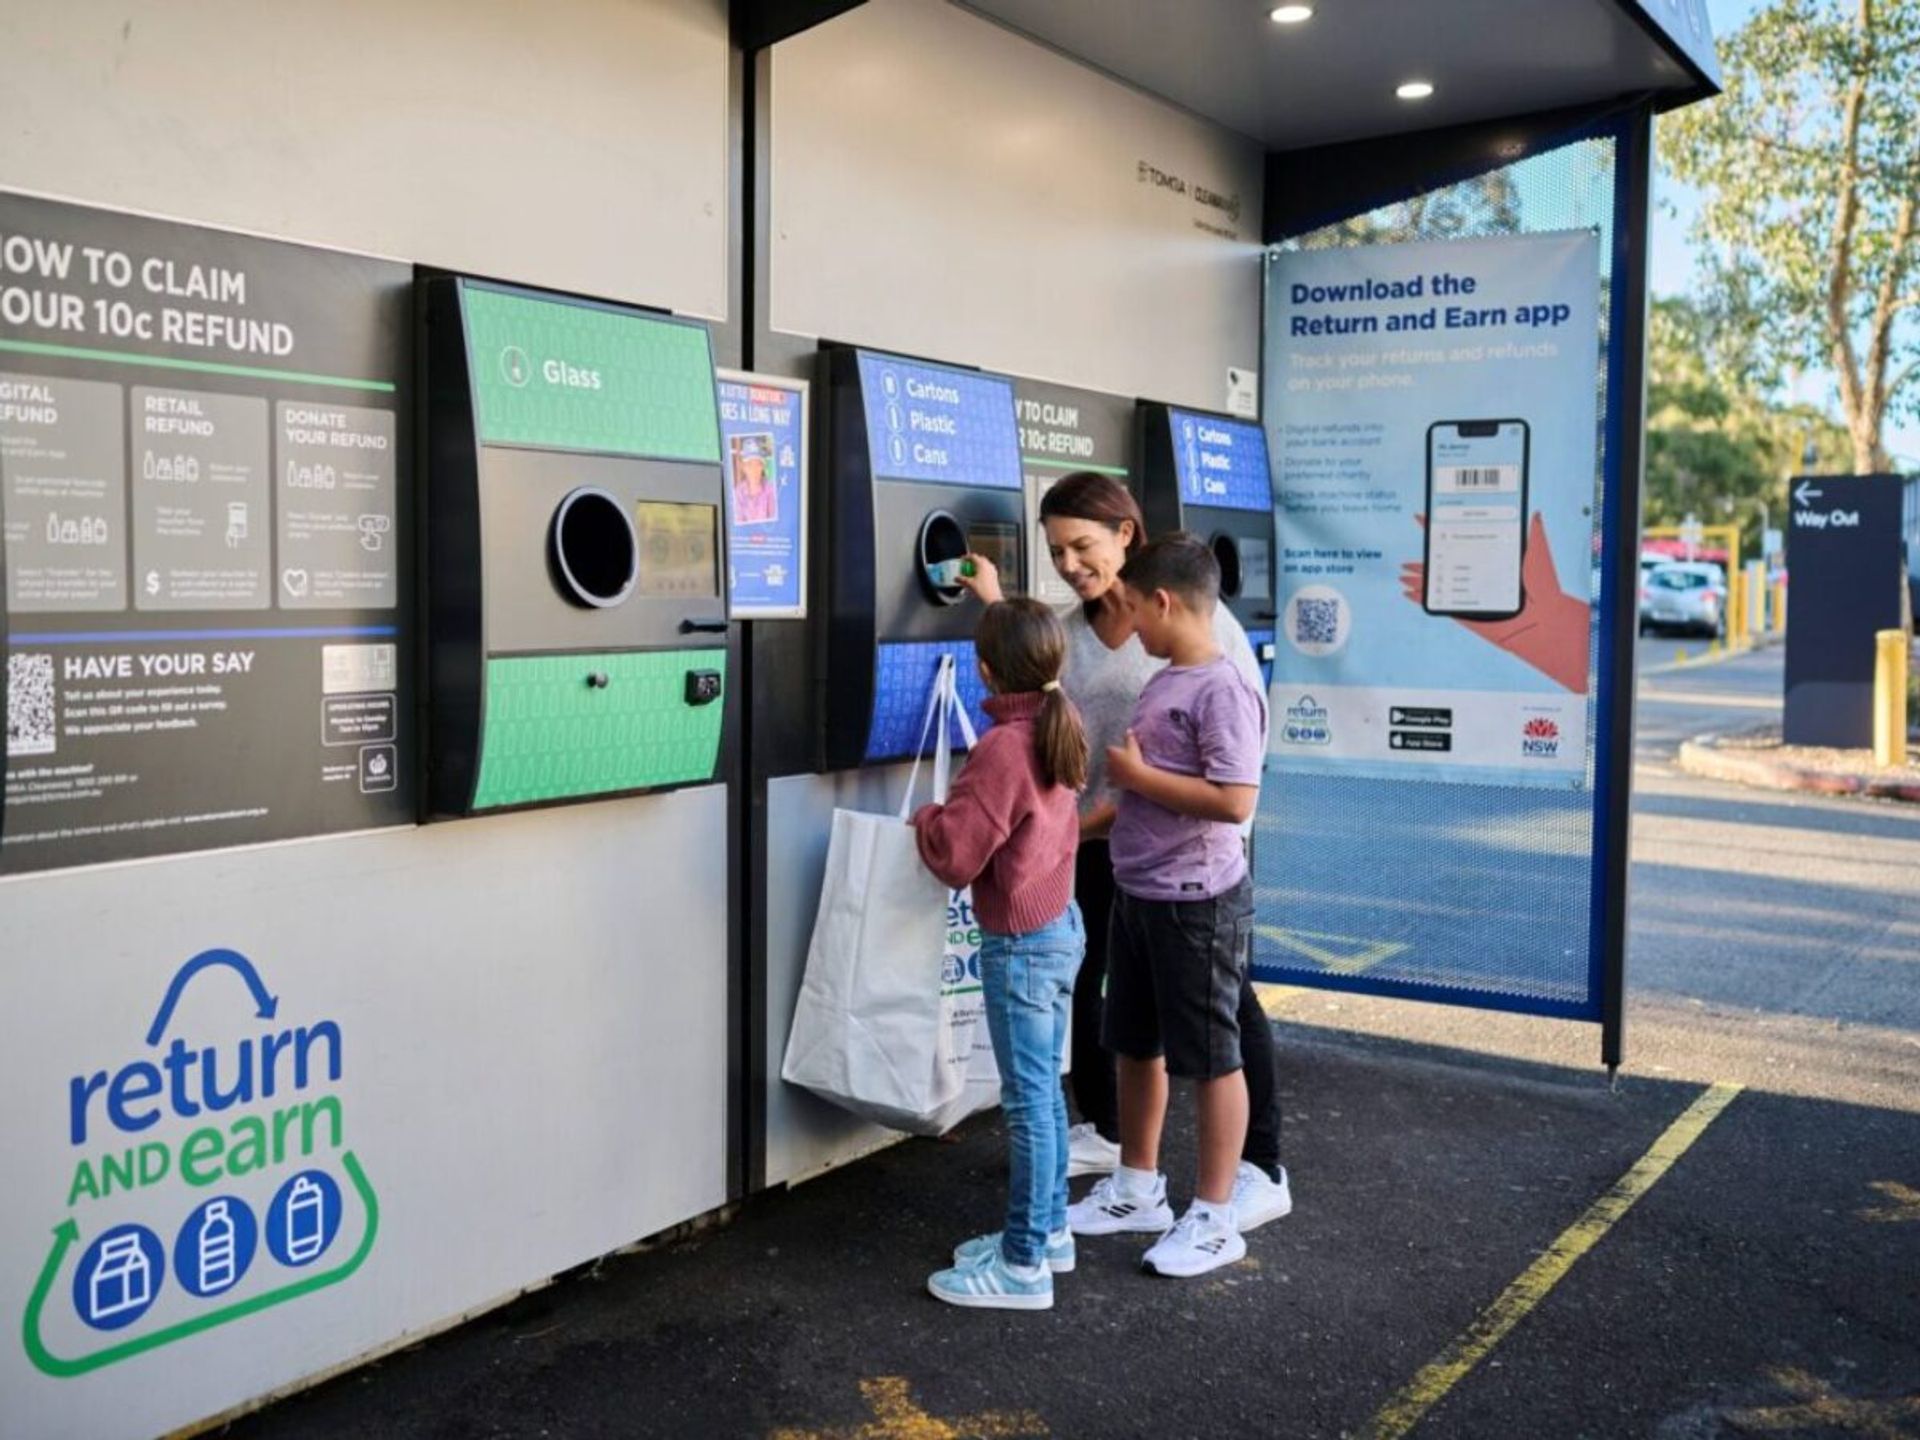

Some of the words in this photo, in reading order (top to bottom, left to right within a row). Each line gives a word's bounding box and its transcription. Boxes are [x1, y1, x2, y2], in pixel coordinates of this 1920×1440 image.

[0, 234, 73, 280] OW
[83, 247, 132, 288] TO
[141, 258, 246, 304] CLAIM
[1291, 275, 1423, 305] Download
[1432, 273, 1475, 295] the
[0, 286, 85, 332] OUR
[94, 299, 152, 339] 10c
[162, 308, 293, 356] REFUND
[1291, 314, 1378, 337] Return
[1386, 308, 1436, 332] and
[1445, 306, 1506, 329] Earn
[1515, 303, 1570, 327] app
[1291, 353, 1333, 368] Track
[1340, 353, 1377, 369] your
[1382, 349, 1444, 365] returns
[1450, 346, 1483, 362] and
[1488, 341, 1558, 360] refunds
[543, 360, 601, 390] Glass
[1287, 378, 1310, 391] on
[1314, 375, 1351, 392] your
[0, 383, 55, 403] GITAL
[906, 378, 959, 404] Cartons
[0, 404, 58, 424] EFUND
[145, 396, 203, 415] RETAIL
[1024, 400, 1041, 423] TO
[1043, 404, 1078, 428] CLAIM
[145, 416, 214, 436] REFUND
[286, 408, 346, 429] DONATE
[910, 410, 957, 435] Plastic
[286, 429, 328, 445] YOUR
[331, 432, 388, 449] REFUND
[1027, 430, 1046, 452] 10c
[1048, 431, 1095, 457] REFUND
[913, 444, 948, 465] Cans
[1794, 510, 1829, 529] Way
[1284, 548, 1311, 560] Scan
[1314, 547, 1338, 560] here
[1342, 548, 1354, 560] to
[1357, 549, 1383, 560] view
[1301, 565, 1322, 576] app
[1326, 563, 1354, 574] store
[146, 570, 160, 594] $
[64, 655, 132, 680] HAVE
[139, 653, 206, 676] YOUR
[212, 651, 255, 673] SAY
[64, 690, 80, 701] Tell
[95, 689, 122, 699] about
[125, 690, 145, 700] your
[147, 687, 194, 698] experience
[64, 707, 87, 718] Scan
[108, 705, 123, 716] QR
[125, 704, 147, 715] code
[83, 722, 131, 736] appreciate
[133, 722, 154, 733] your
[1523, 739, 1558, 753] NSW
[70, 1020, 342, 1146] return
[68, 1142, 170, 1206] AND
[179, 1095, 342, 1187] earn
